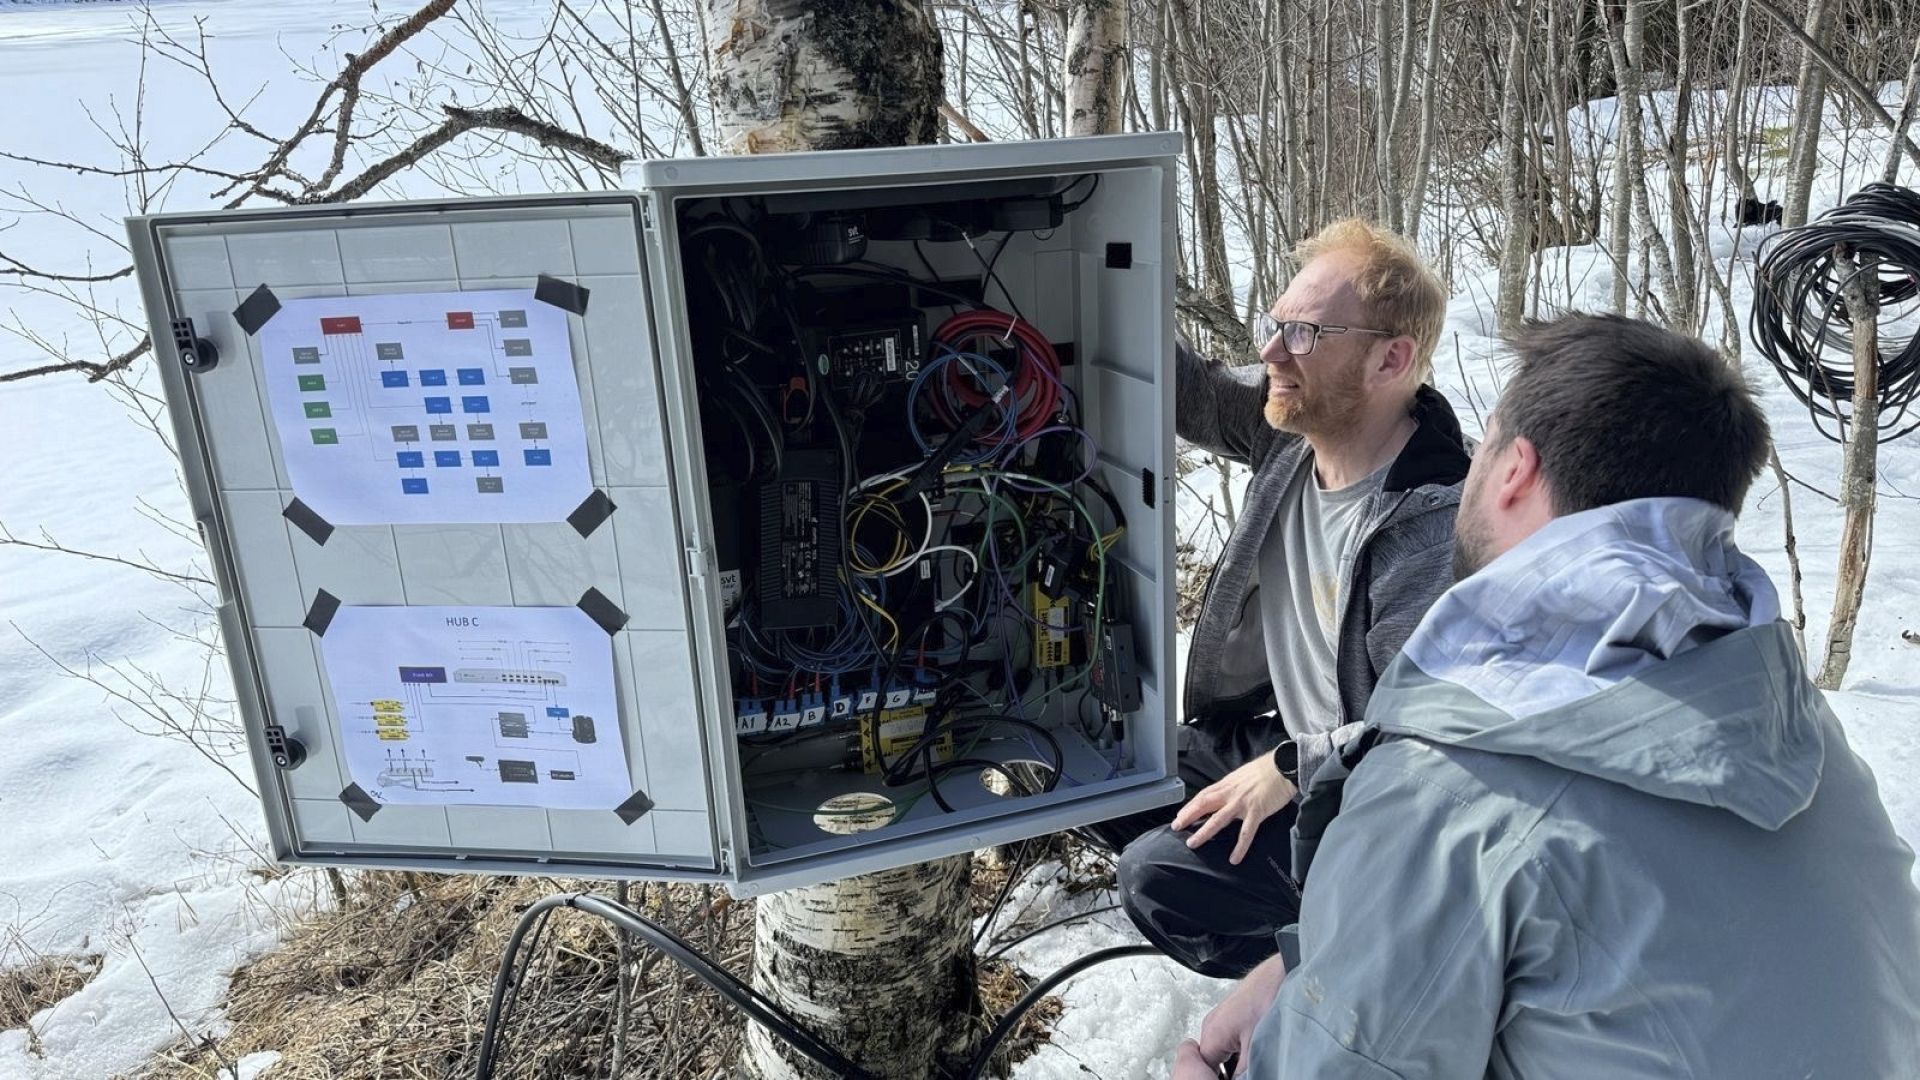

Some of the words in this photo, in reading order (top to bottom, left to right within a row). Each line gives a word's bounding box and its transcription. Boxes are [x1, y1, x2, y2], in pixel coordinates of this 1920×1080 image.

[445, 617, 470, 627] HUB
[472, 617, 480, 627] C
[835, 702, 845, 713] D
[808, 711, 816, 721] B
[741, 716, 755, 729] A1
[774, 717, 791, 728] A2
